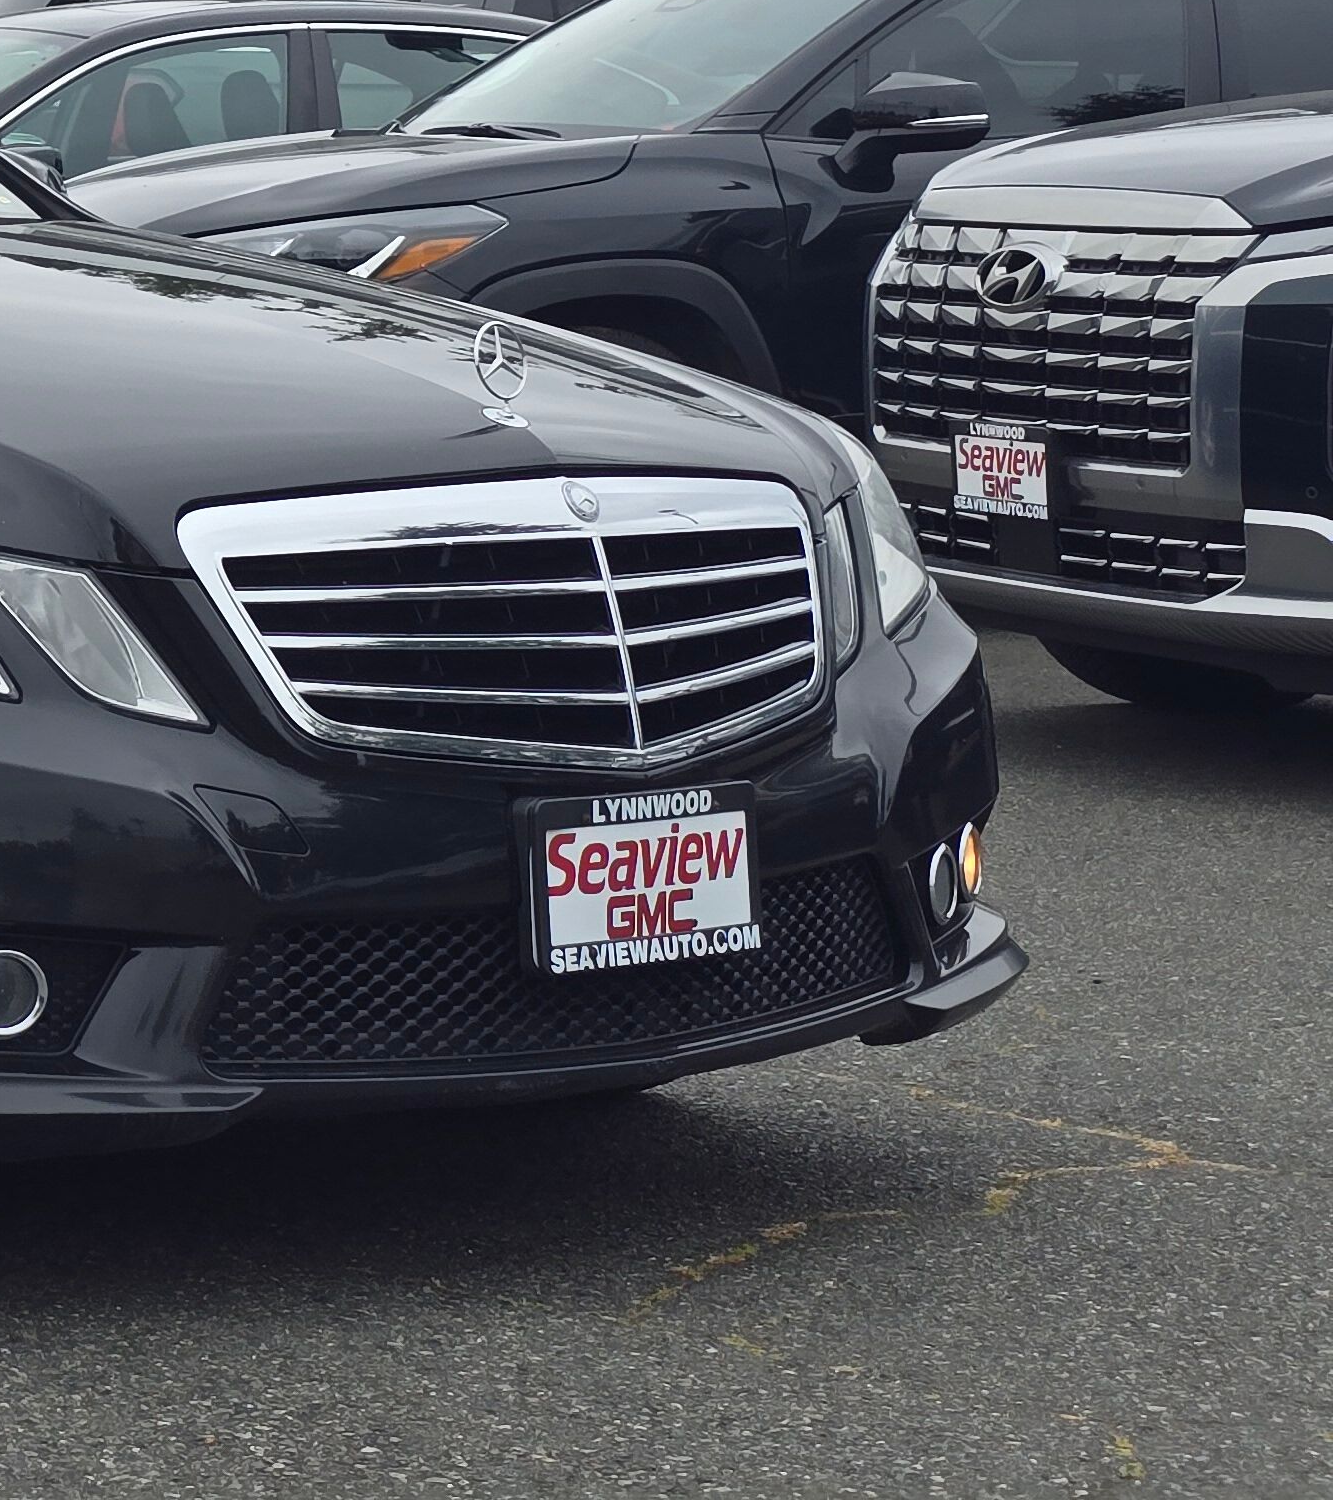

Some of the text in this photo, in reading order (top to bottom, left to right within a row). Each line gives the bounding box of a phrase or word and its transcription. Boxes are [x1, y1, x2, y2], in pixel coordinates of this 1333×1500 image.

[958, 437, 1047, 478] Seaview
[982, 474, 1025, 501] GMC
[591, 789, 712, 824] LYNNWOOD
[547, 822, 745, 897] Seaview
[605, 888, 699, 941] GMC
[549, 924, 762, 975] SEAVIEWAUTO.COM
